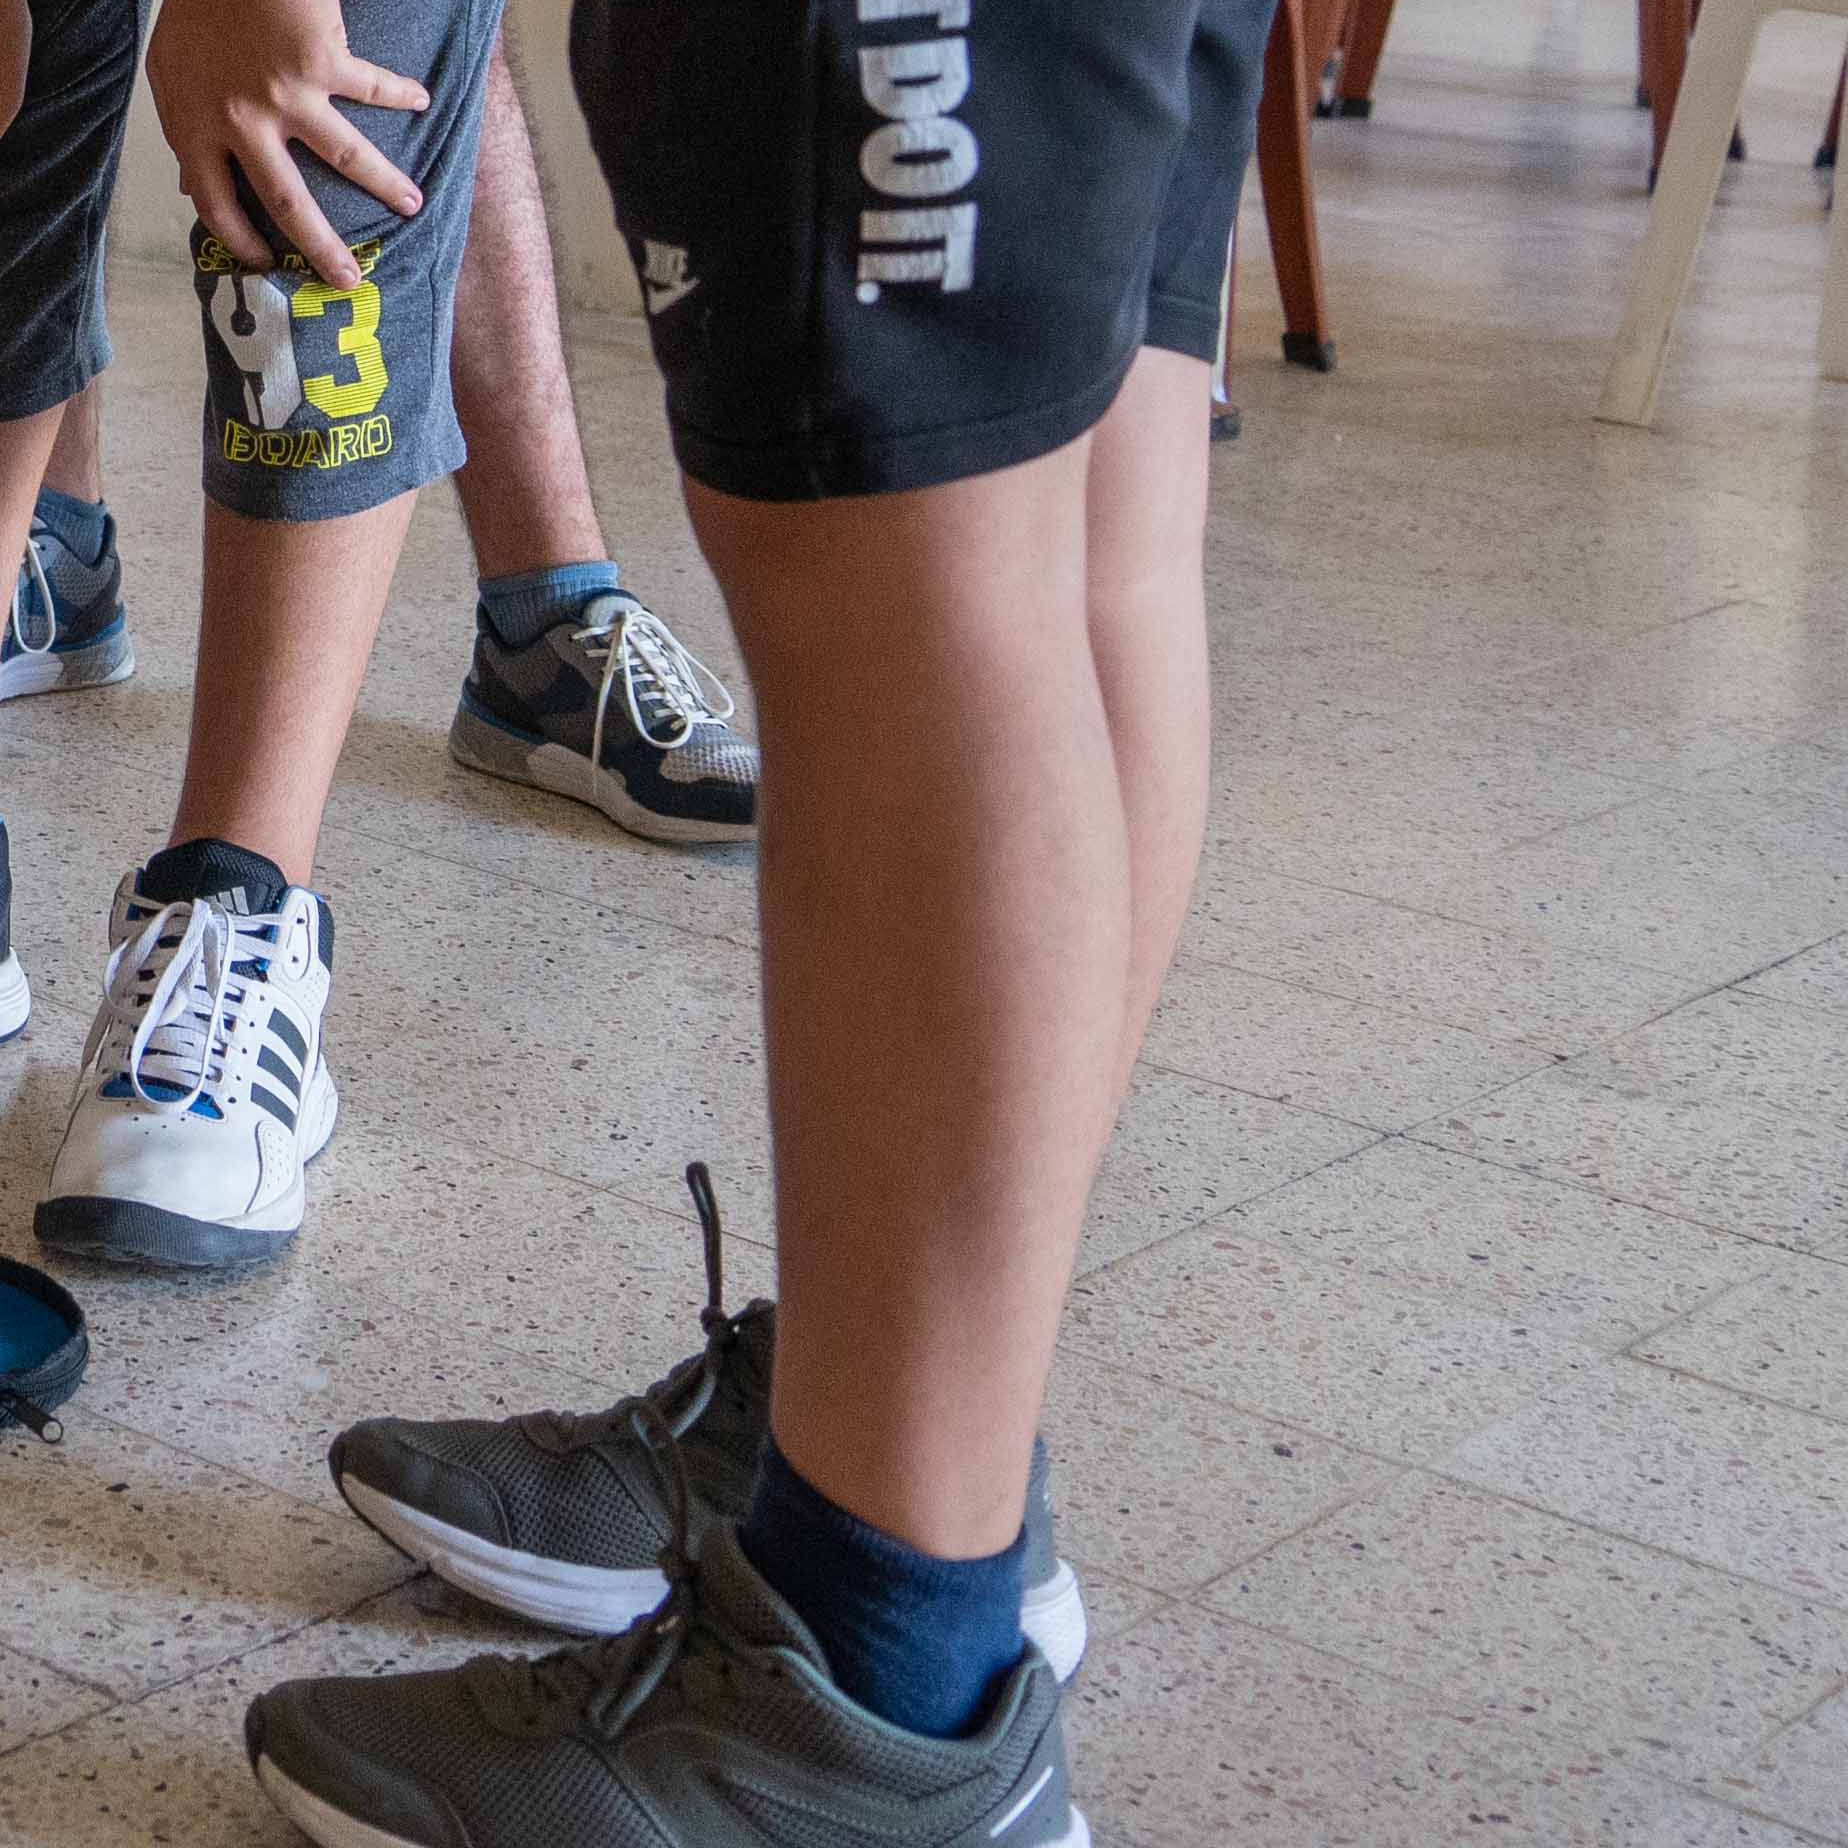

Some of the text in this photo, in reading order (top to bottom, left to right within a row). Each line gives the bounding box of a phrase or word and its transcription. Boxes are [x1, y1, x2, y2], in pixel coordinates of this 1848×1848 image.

[857, 37, 980, 199] DO
[856, 202, 979, 304] IT.
[223, 413, 393, 469] BOARD
